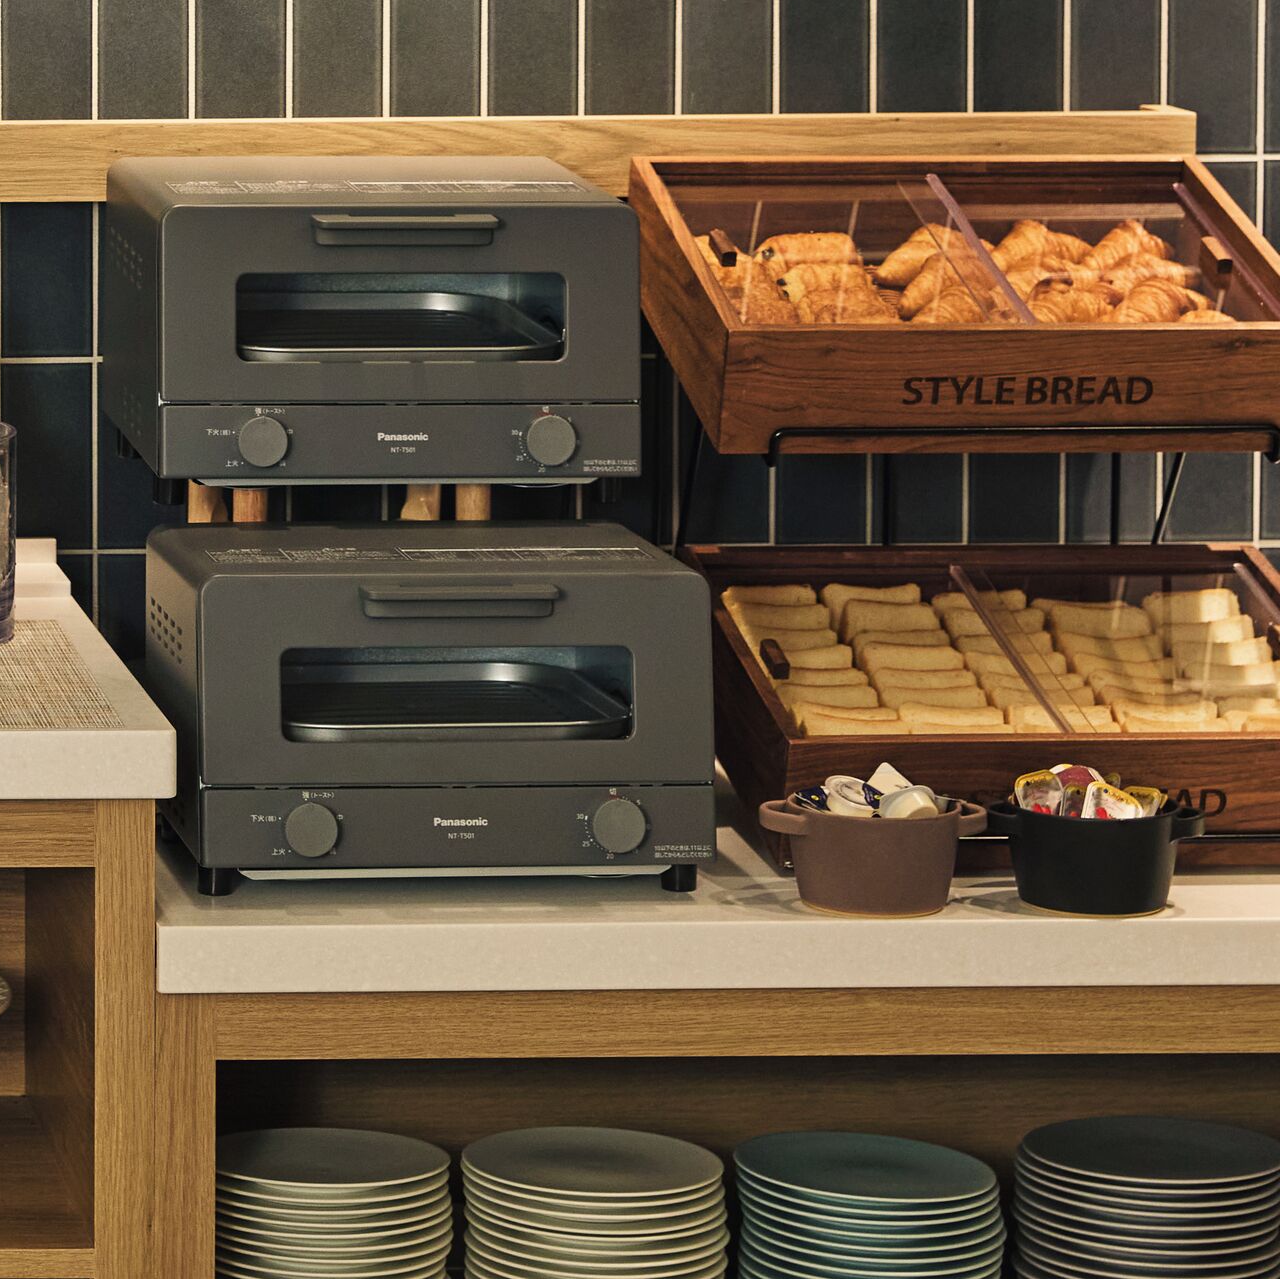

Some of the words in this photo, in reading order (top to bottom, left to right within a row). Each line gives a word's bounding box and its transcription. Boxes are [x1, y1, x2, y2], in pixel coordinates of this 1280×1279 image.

[902, 376, 1016, 405] STYLE
[1025, 376, 1154, 405] BREAD
[377, 432, 429, 441] Panasonic
[433, 817, 489, 827] Panasonic
